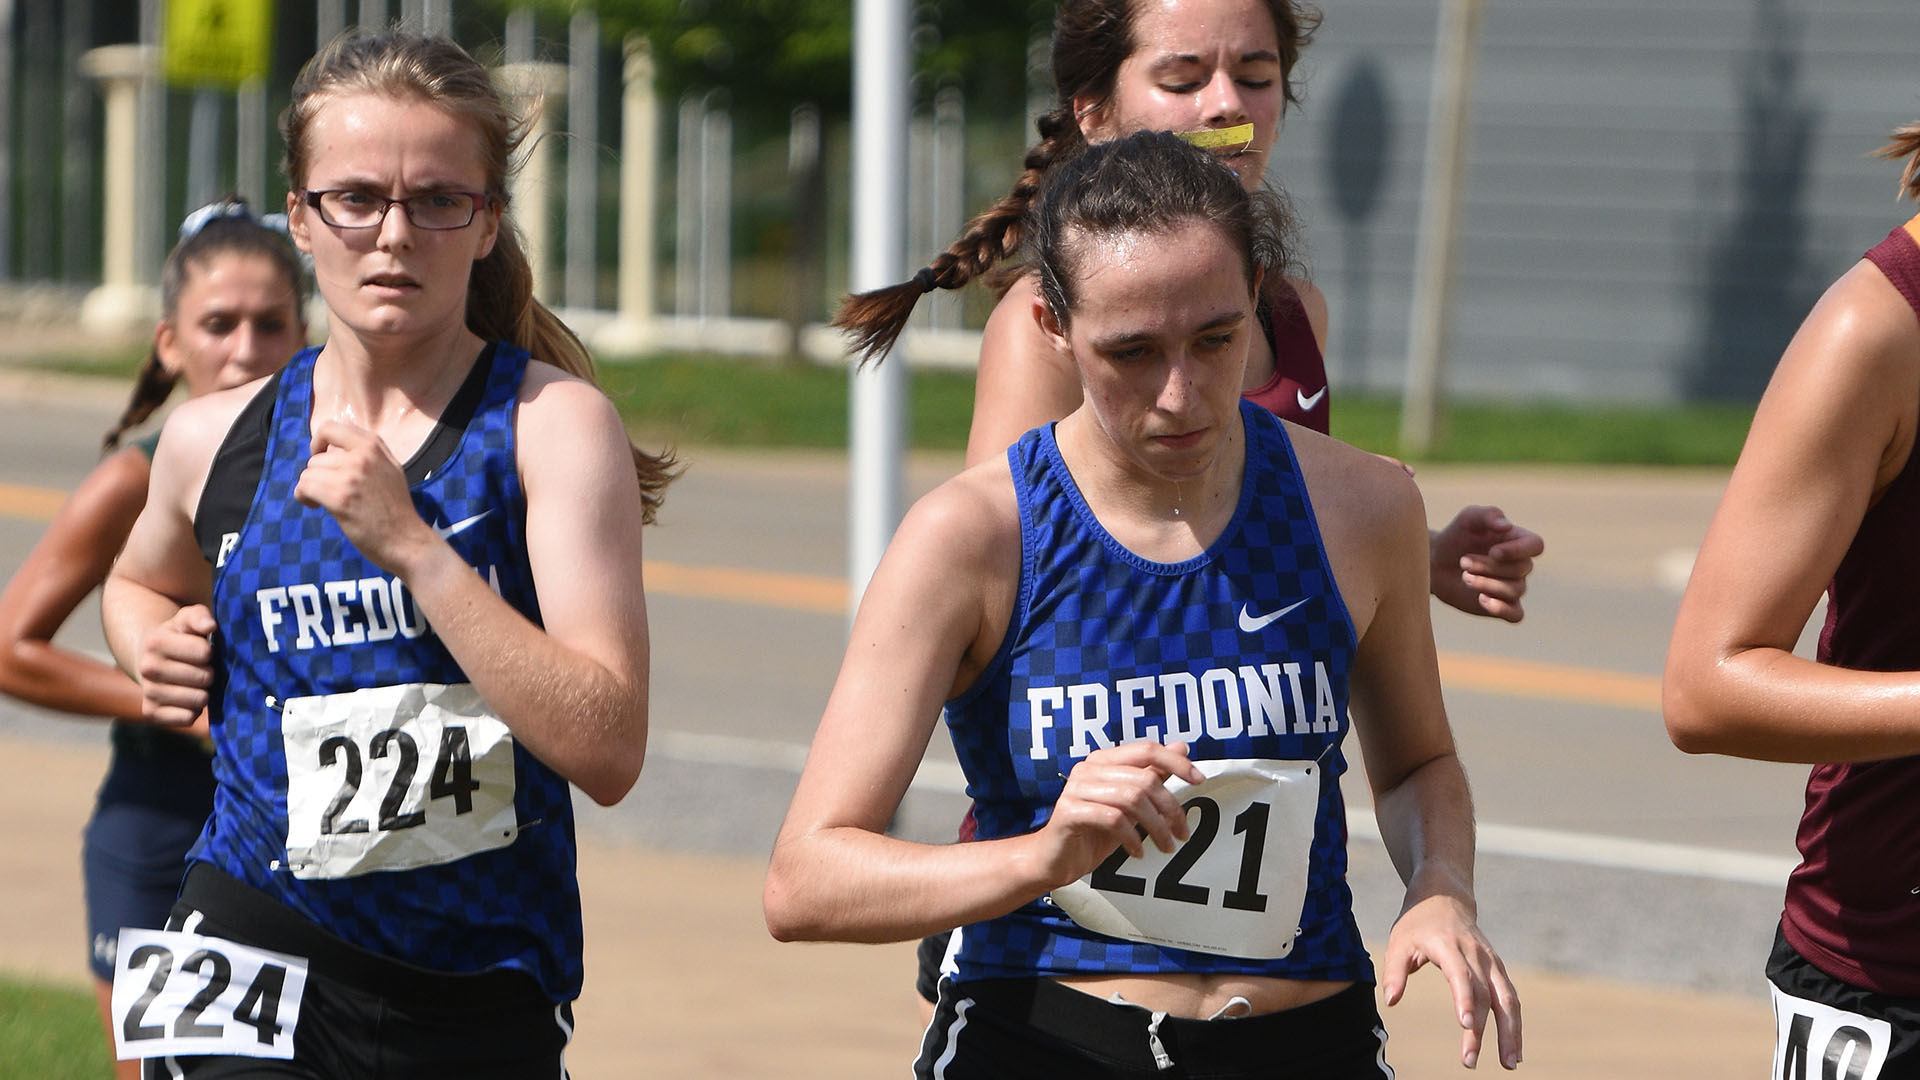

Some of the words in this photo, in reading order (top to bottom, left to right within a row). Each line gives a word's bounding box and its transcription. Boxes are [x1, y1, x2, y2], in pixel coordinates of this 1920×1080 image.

[257, 564, 503, 653] FREDO
[1027, 661, 1339, 760] FREDONIA
[319, 726, 480, 836] 224
[123, 944, 288, 1047] 224
